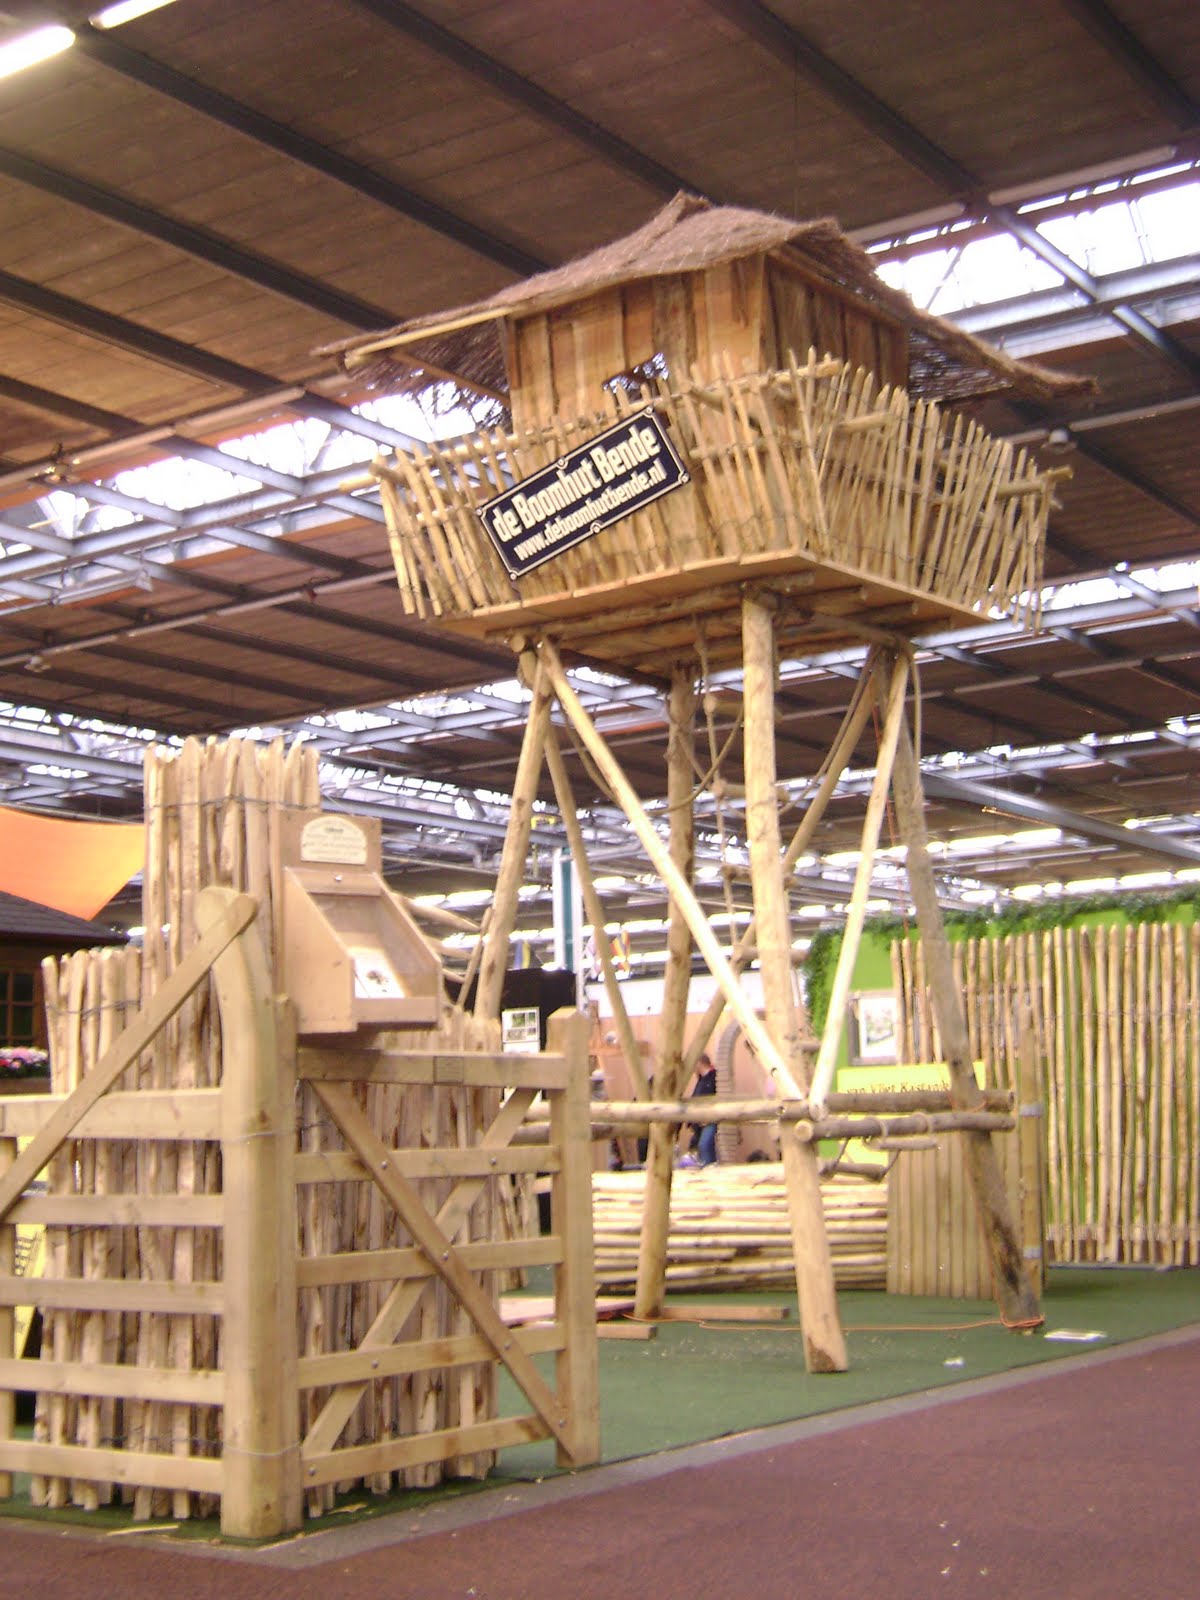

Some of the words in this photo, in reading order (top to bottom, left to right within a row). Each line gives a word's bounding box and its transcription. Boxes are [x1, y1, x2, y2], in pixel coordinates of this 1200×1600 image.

[492, 506, 522, 542] de
[511, 456, 603, 529] Boomhut
[590, 424, 661, 483] Bende
[513, 458, 668, 561] www.deboomhutbende.nl
